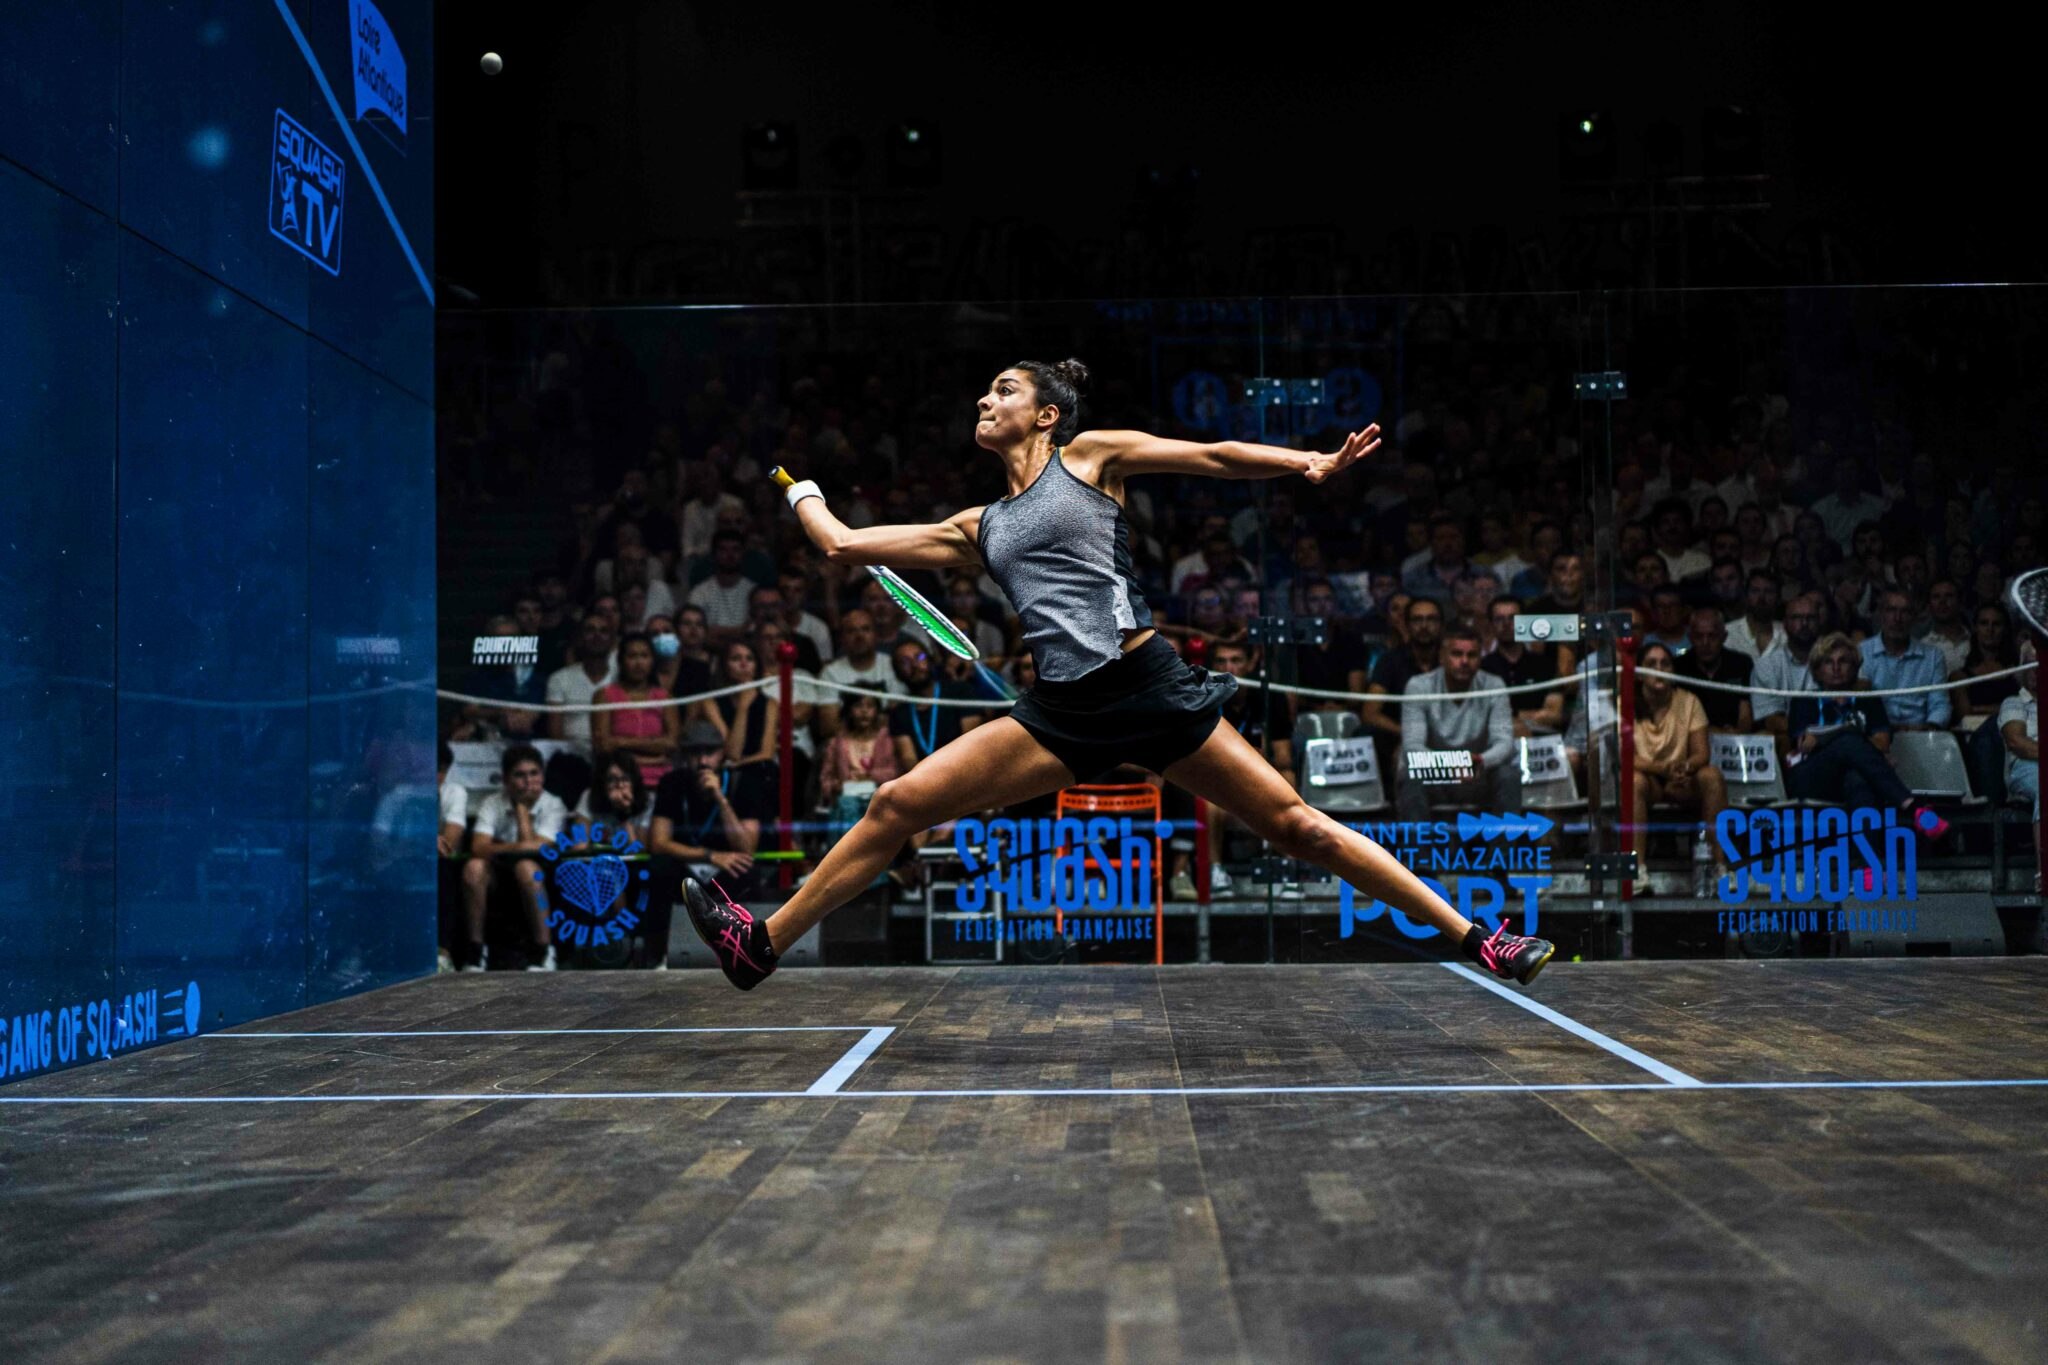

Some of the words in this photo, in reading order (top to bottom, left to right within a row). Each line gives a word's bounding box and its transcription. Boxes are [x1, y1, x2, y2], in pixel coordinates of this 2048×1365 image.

[359, 46, 404, 117] Atlantique
[278, 121, 343, 198] SQUASH
[301, 187, 339, 259] TV
[473, 635, 539, 654] COURTWALL
[539, 822, 605, 861] GANG
[612, 830, 645, 855] OF
[1350, 821, 1450, 845] ANTES
[1396, 847, 1552, 871] T-NAZAIRE
[1339, 874, 1553, 940] PORT
[1717, 906, 1820, 934] FÉDÉRATION
[544, 907, 640, 947] SQUASH
[954, 916, 1054, 942] FÉDÉRATION
[1062, 917, 1153, 943] FRANÇAISE
[0, 1009, 52, 1079] GANG
[57, 1005, 82, 1064] OF
